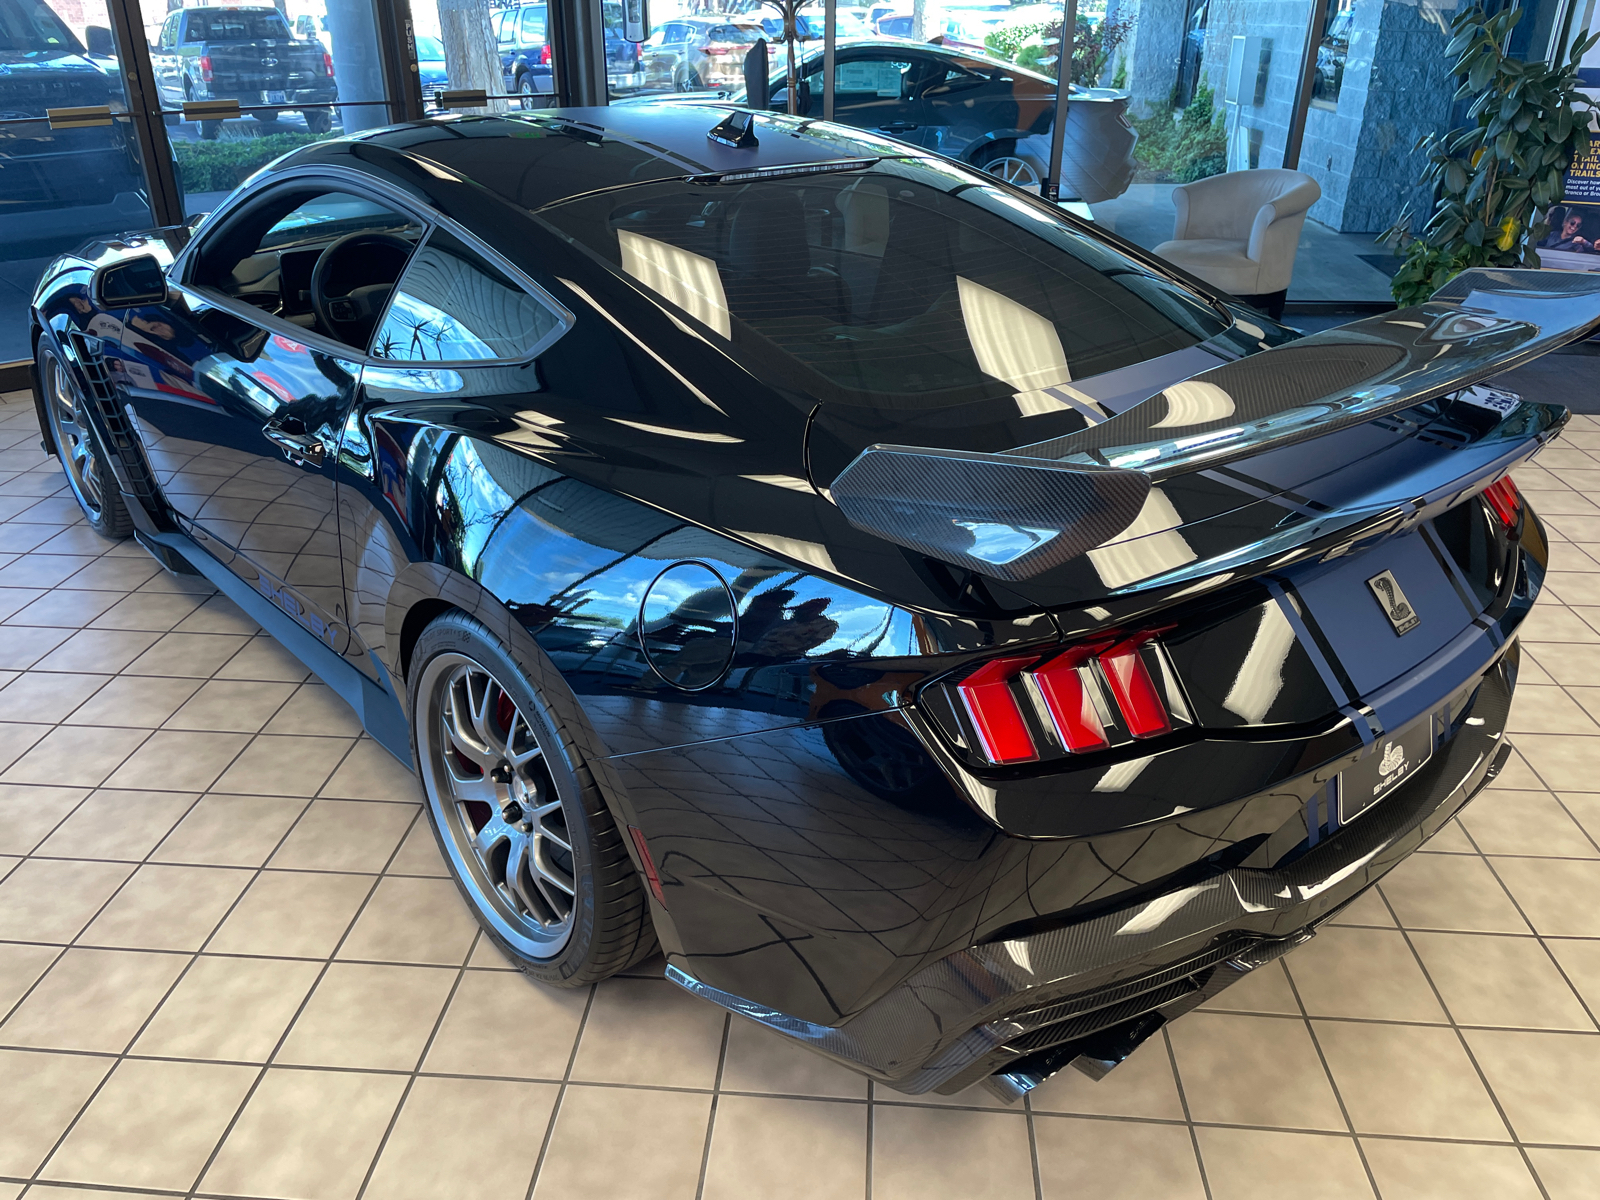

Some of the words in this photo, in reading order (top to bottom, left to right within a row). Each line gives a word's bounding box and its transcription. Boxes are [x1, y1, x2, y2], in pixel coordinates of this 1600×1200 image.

[405, 23, 413, 50] PUSH
[258, 573, 337, 645] SHELBY
[1373, 760, 1410, 796] SHELBY
